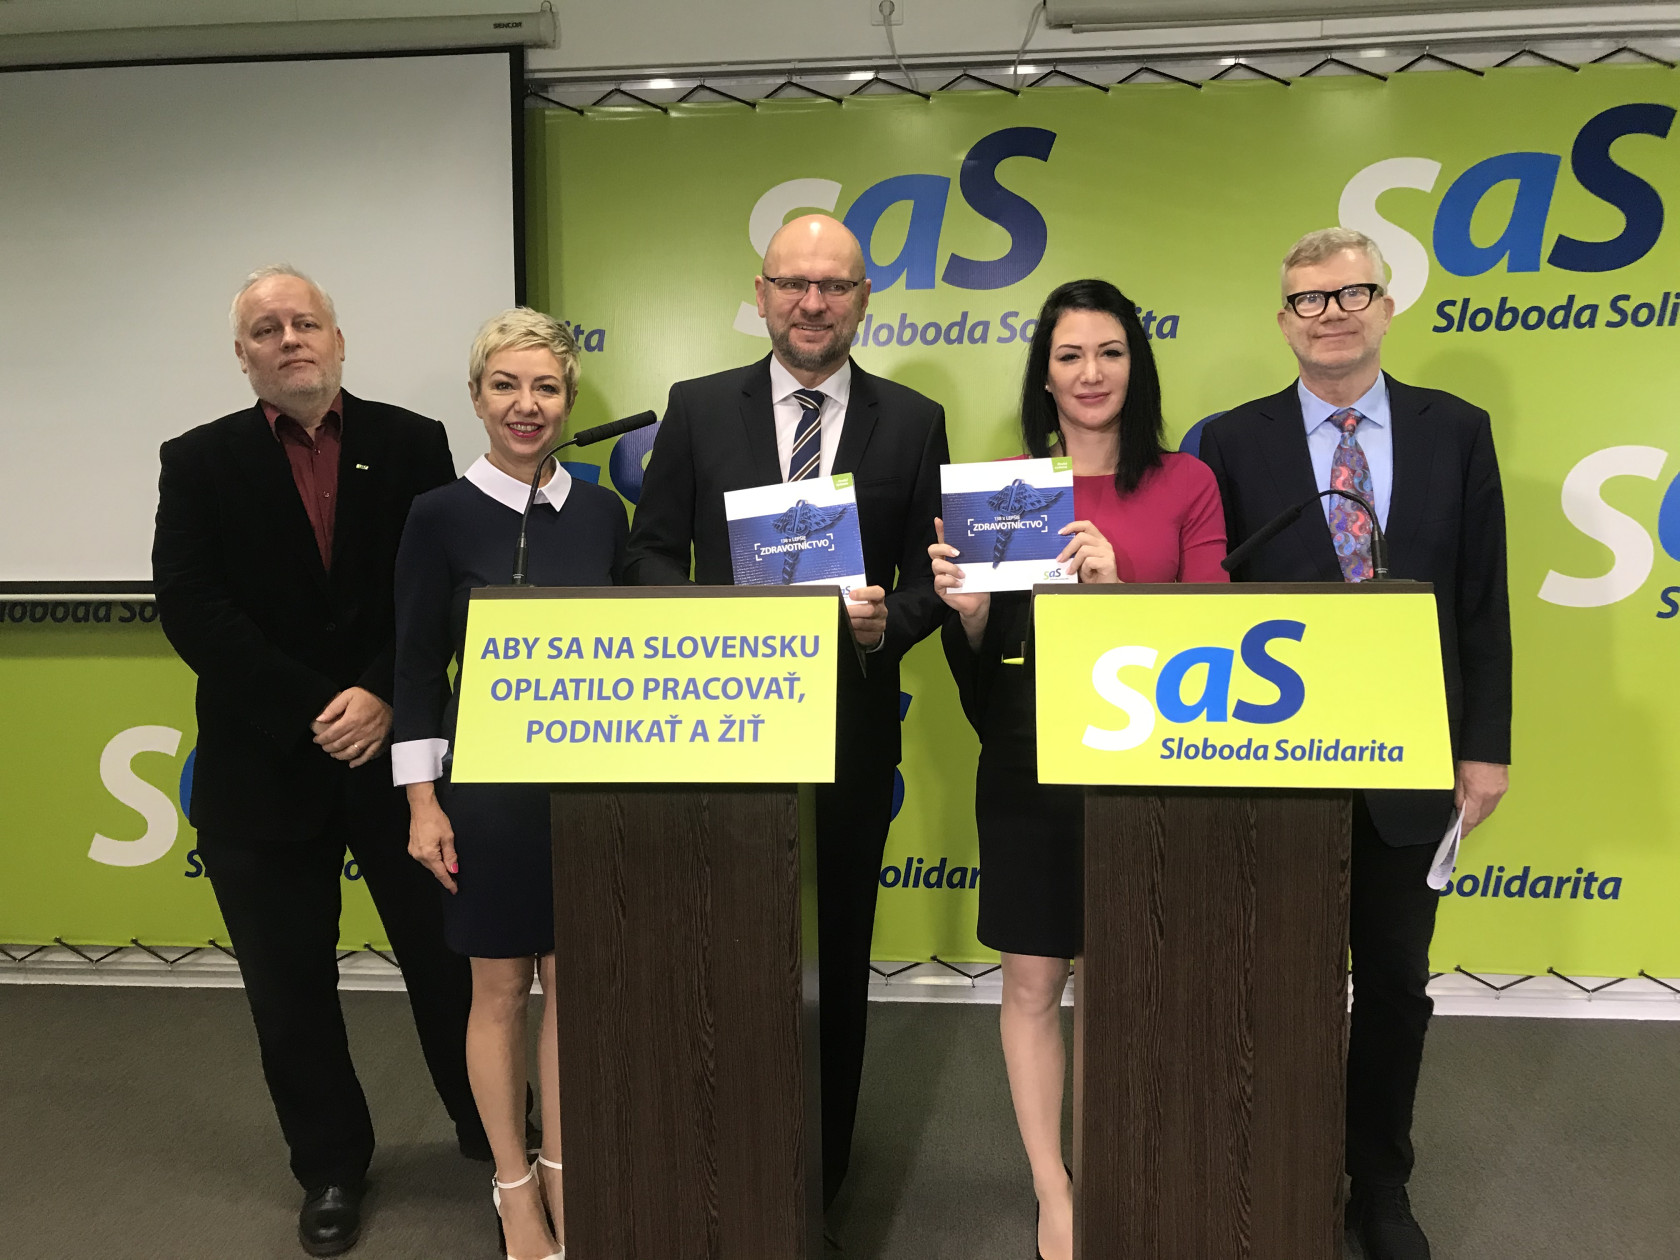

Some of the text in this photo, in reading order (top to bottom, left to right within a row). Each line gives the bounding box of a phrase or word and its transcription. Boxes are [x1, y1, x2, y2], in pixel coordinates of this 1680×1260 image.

[1432, 294, 1600, 333] Sloboda
[851, 311, 990, 348] loboda
[973, 520, 1043, 531] ZDRAVOTNÍCTVO
[760, 539, 829, 555] ZDRAVOTNÍCTVO
[480, 635, 820, 660] ABY SA NA SLOVENSKU
[490, 672, 806, 703] OPLATILO PRACOVAŤ,
[1081, 619, 1307, 752] SaS
[526, 714, 765, 743] PODNIKAŤ A ŽIŤ
[1160, 737, 1404, 762] Sloboda Solidarita
